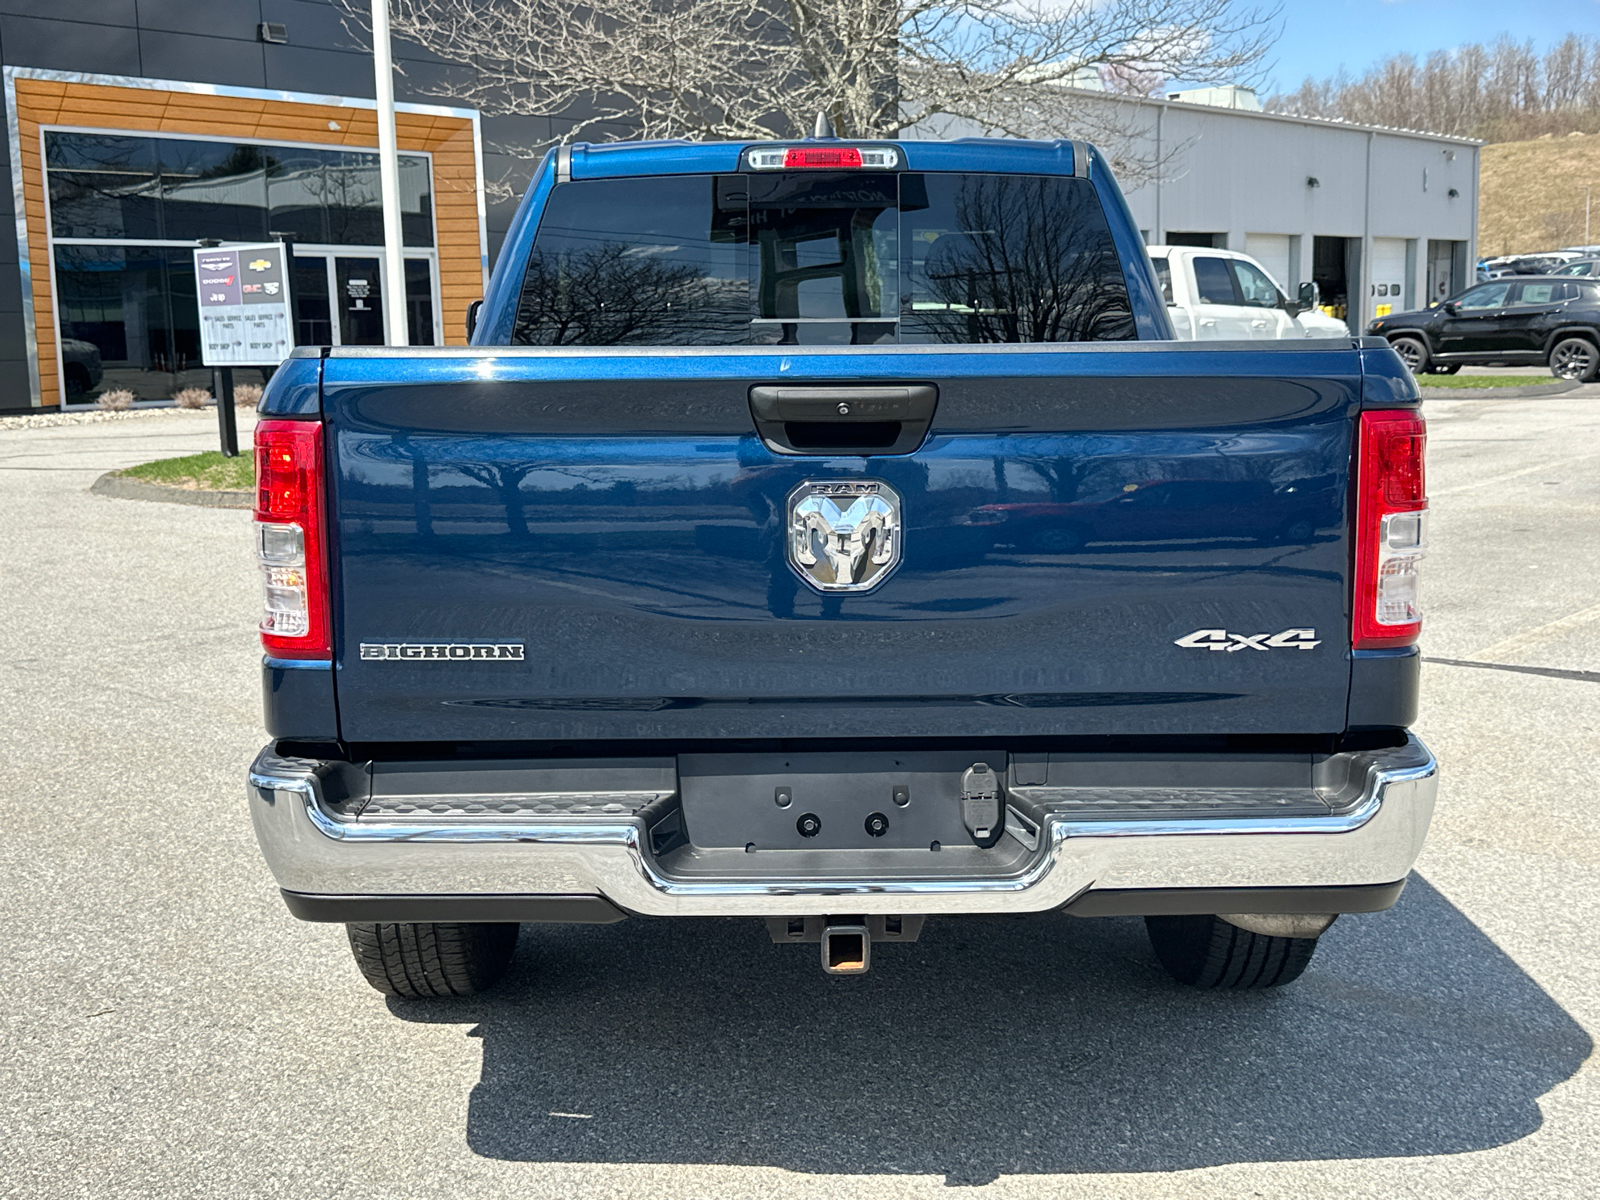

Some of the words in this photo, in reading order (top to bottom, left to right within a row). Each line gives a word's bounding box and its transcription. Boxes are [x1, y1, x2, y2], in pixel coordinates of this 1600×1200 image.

[250, 342, 261, 350] BODY
[810, 483, 880, 494] RAM
[1173, 627, 1322, 652] 4x4
[359, 642, 525, 661] BIGHORN
